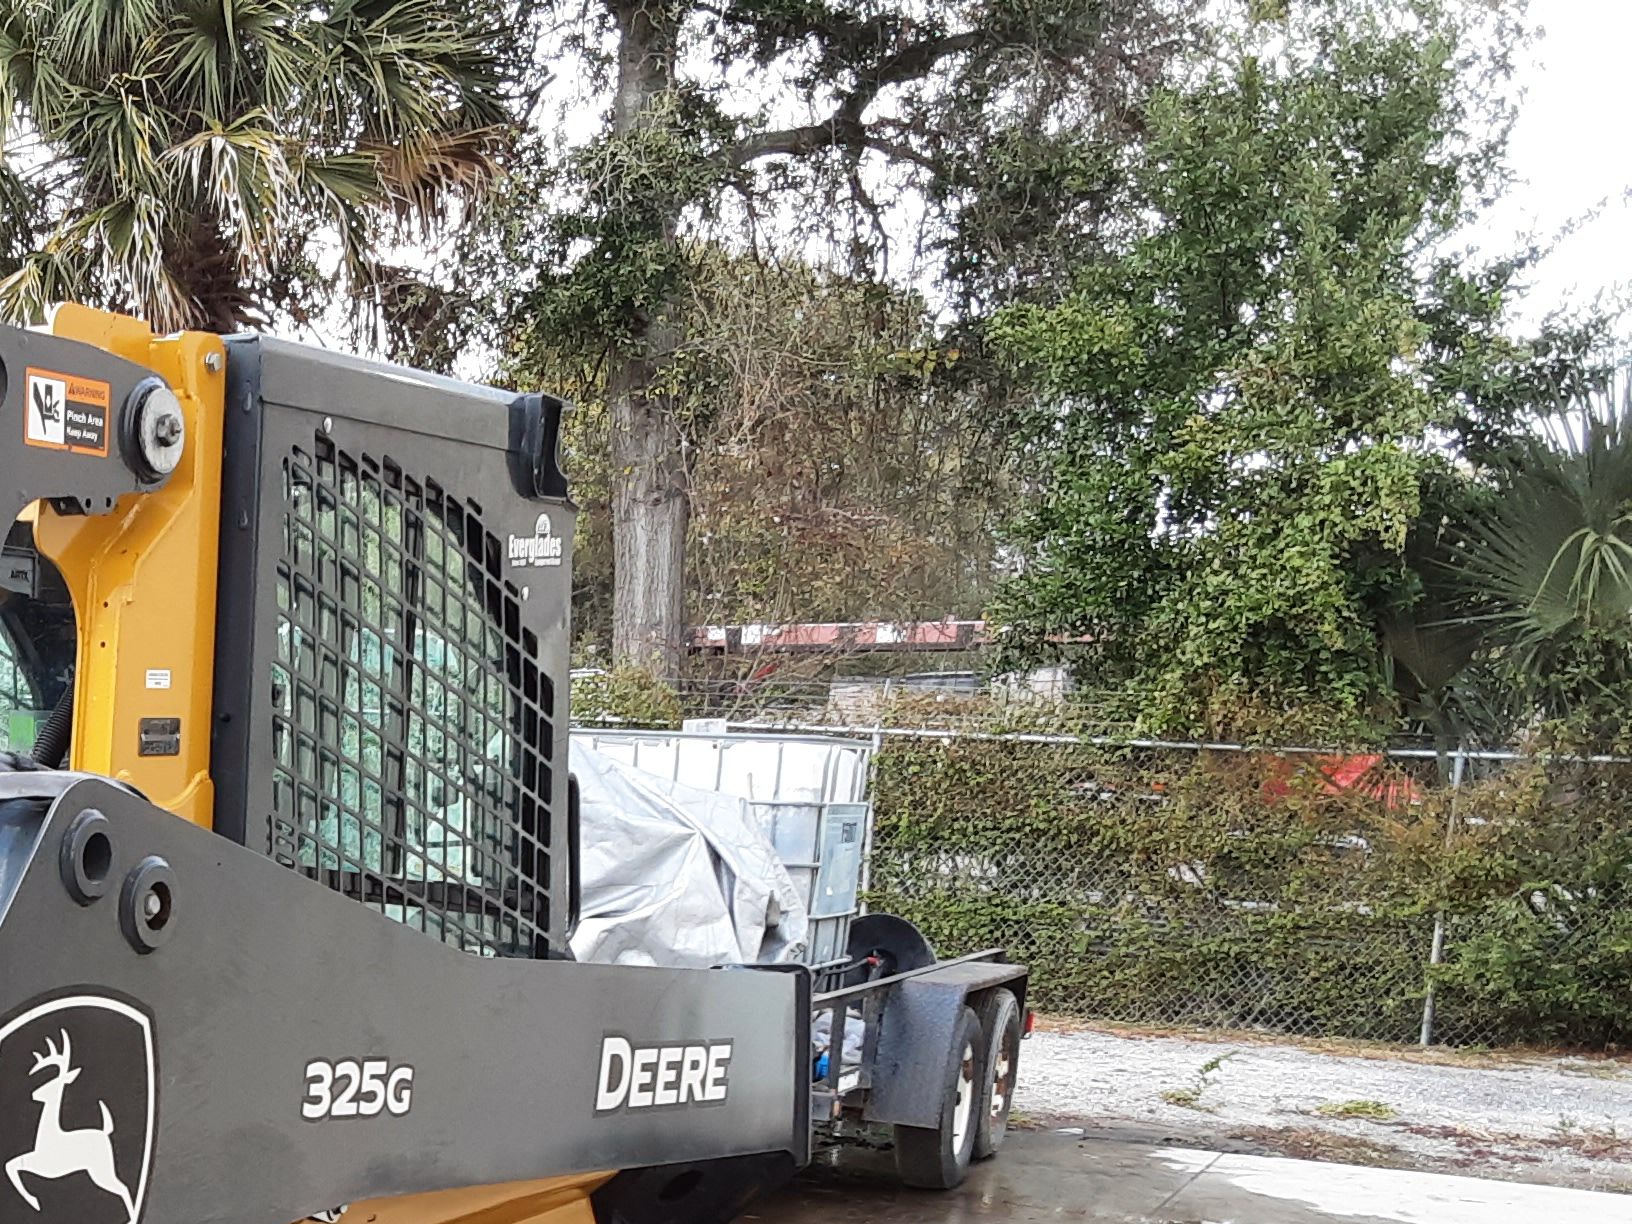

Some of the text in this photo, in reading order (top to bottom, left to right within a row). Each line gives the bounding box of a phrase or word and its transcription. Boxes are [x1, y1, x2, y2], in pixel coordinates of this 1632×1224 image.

[67, 409, 103, 427] Pinch Area
[509, 533, 562, 564] Everglades
[302, 1061, 414, 1118] 325G
[596, 1037, 732, 1110] DEERE
